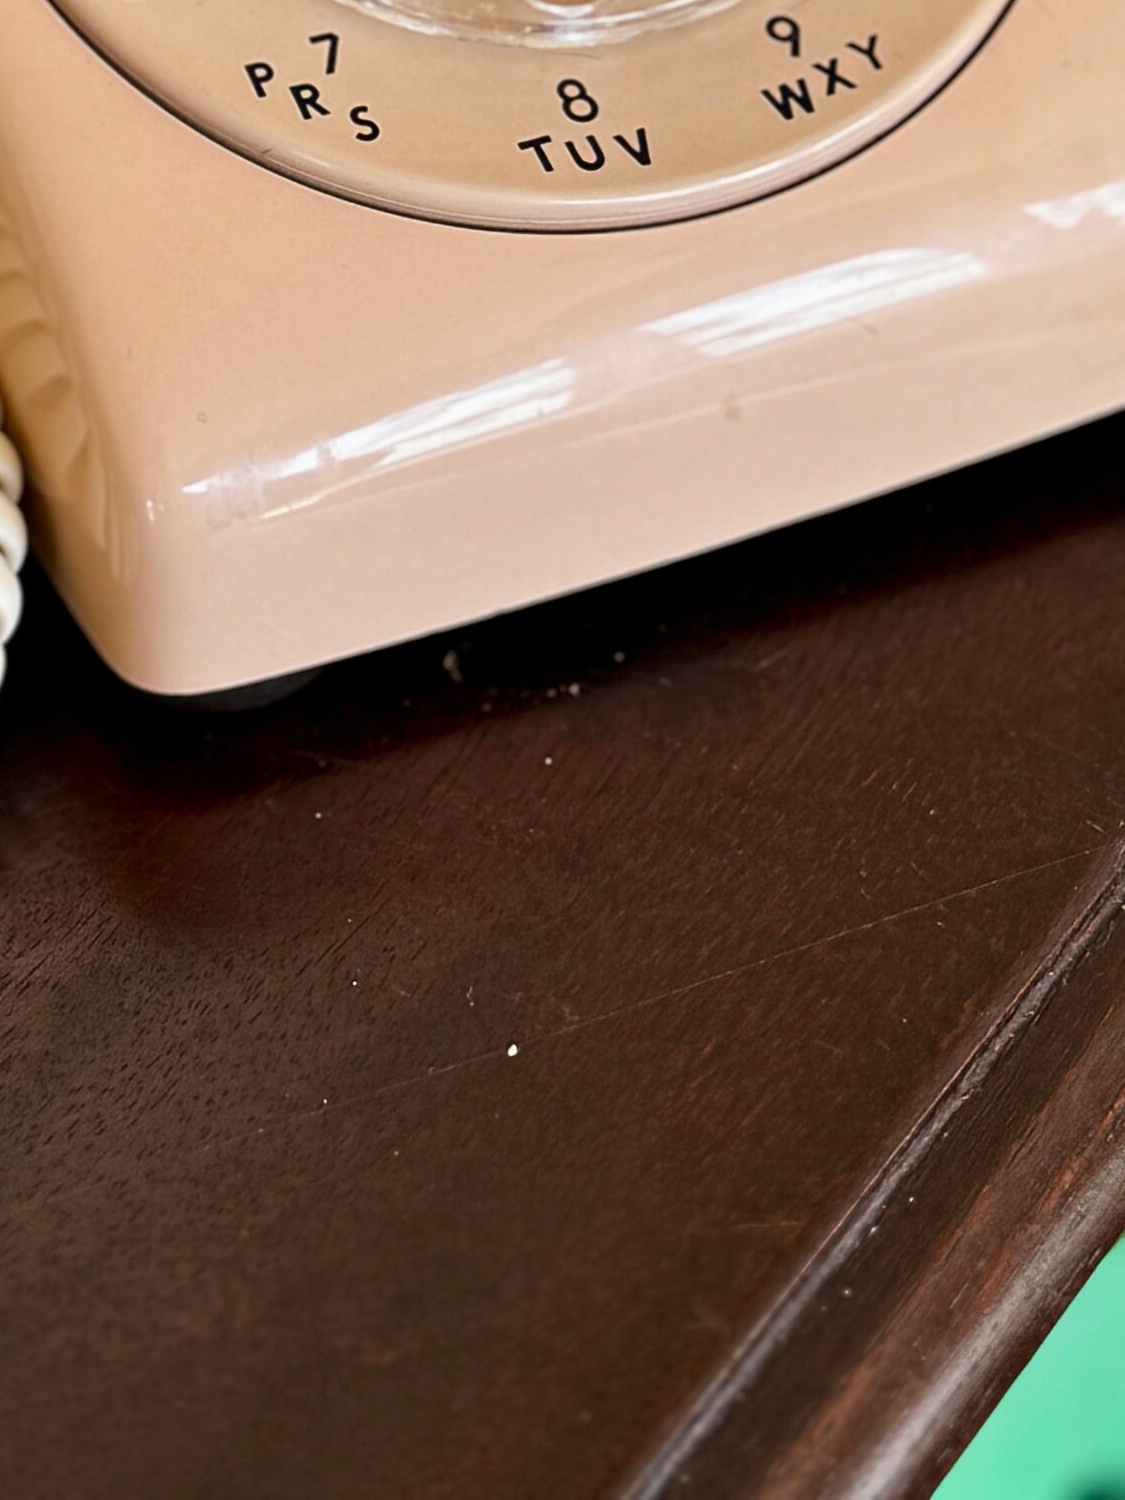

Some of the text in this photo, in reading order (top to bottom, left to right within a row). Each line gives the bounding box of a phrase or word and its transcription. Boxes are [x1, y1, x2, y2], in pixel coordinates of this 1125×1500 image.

[308, 32, 341, 76] 7
[765, 15, 801, 58] 9
[556, 78, 600, 123] 8
[760, 34, 884, 121] WXY
[243, 61, 382, 143] PRS
[517, 127, 653, 174] TUV
